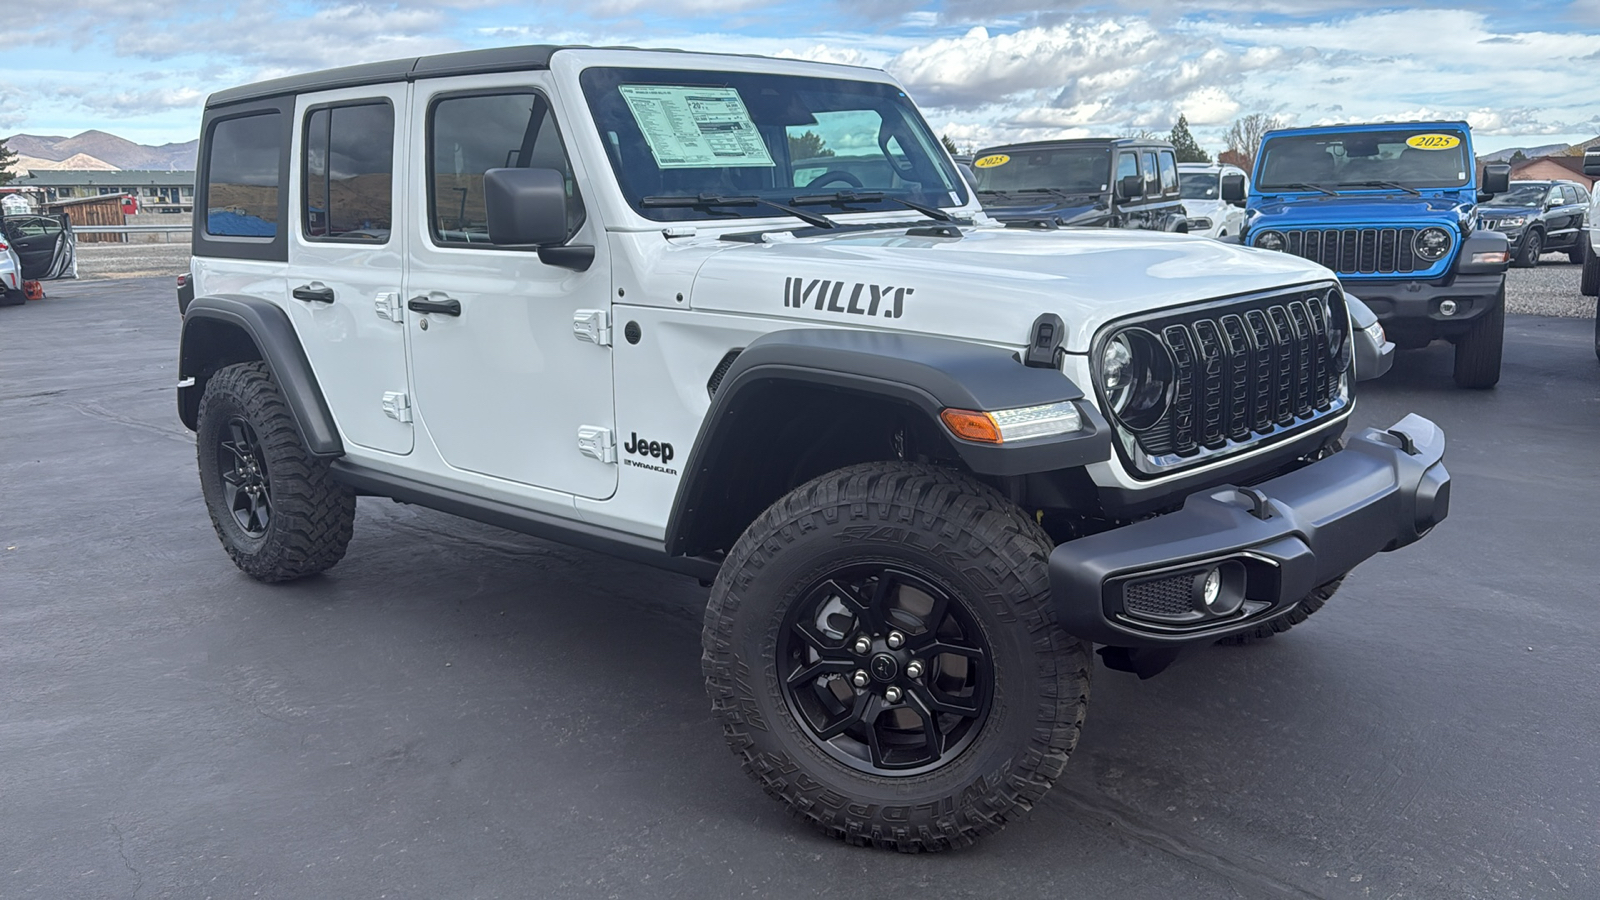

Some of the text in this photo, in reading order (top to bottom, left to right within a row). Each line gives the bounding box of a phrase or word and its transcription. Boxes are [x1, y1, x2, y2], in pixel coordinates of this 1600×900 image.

[1415, 137, 1453, 147] 2025
[981, 156, 1005, 167] 2025
[784, 277, 915, 319] WILLYS
[624, 431, 674, 464] Jeep
[631, 460, 677, 475] WRANGLER
[834, 524, 1017, 622] FALKEN
[766, 750, 989, 823] WILDPEAK
